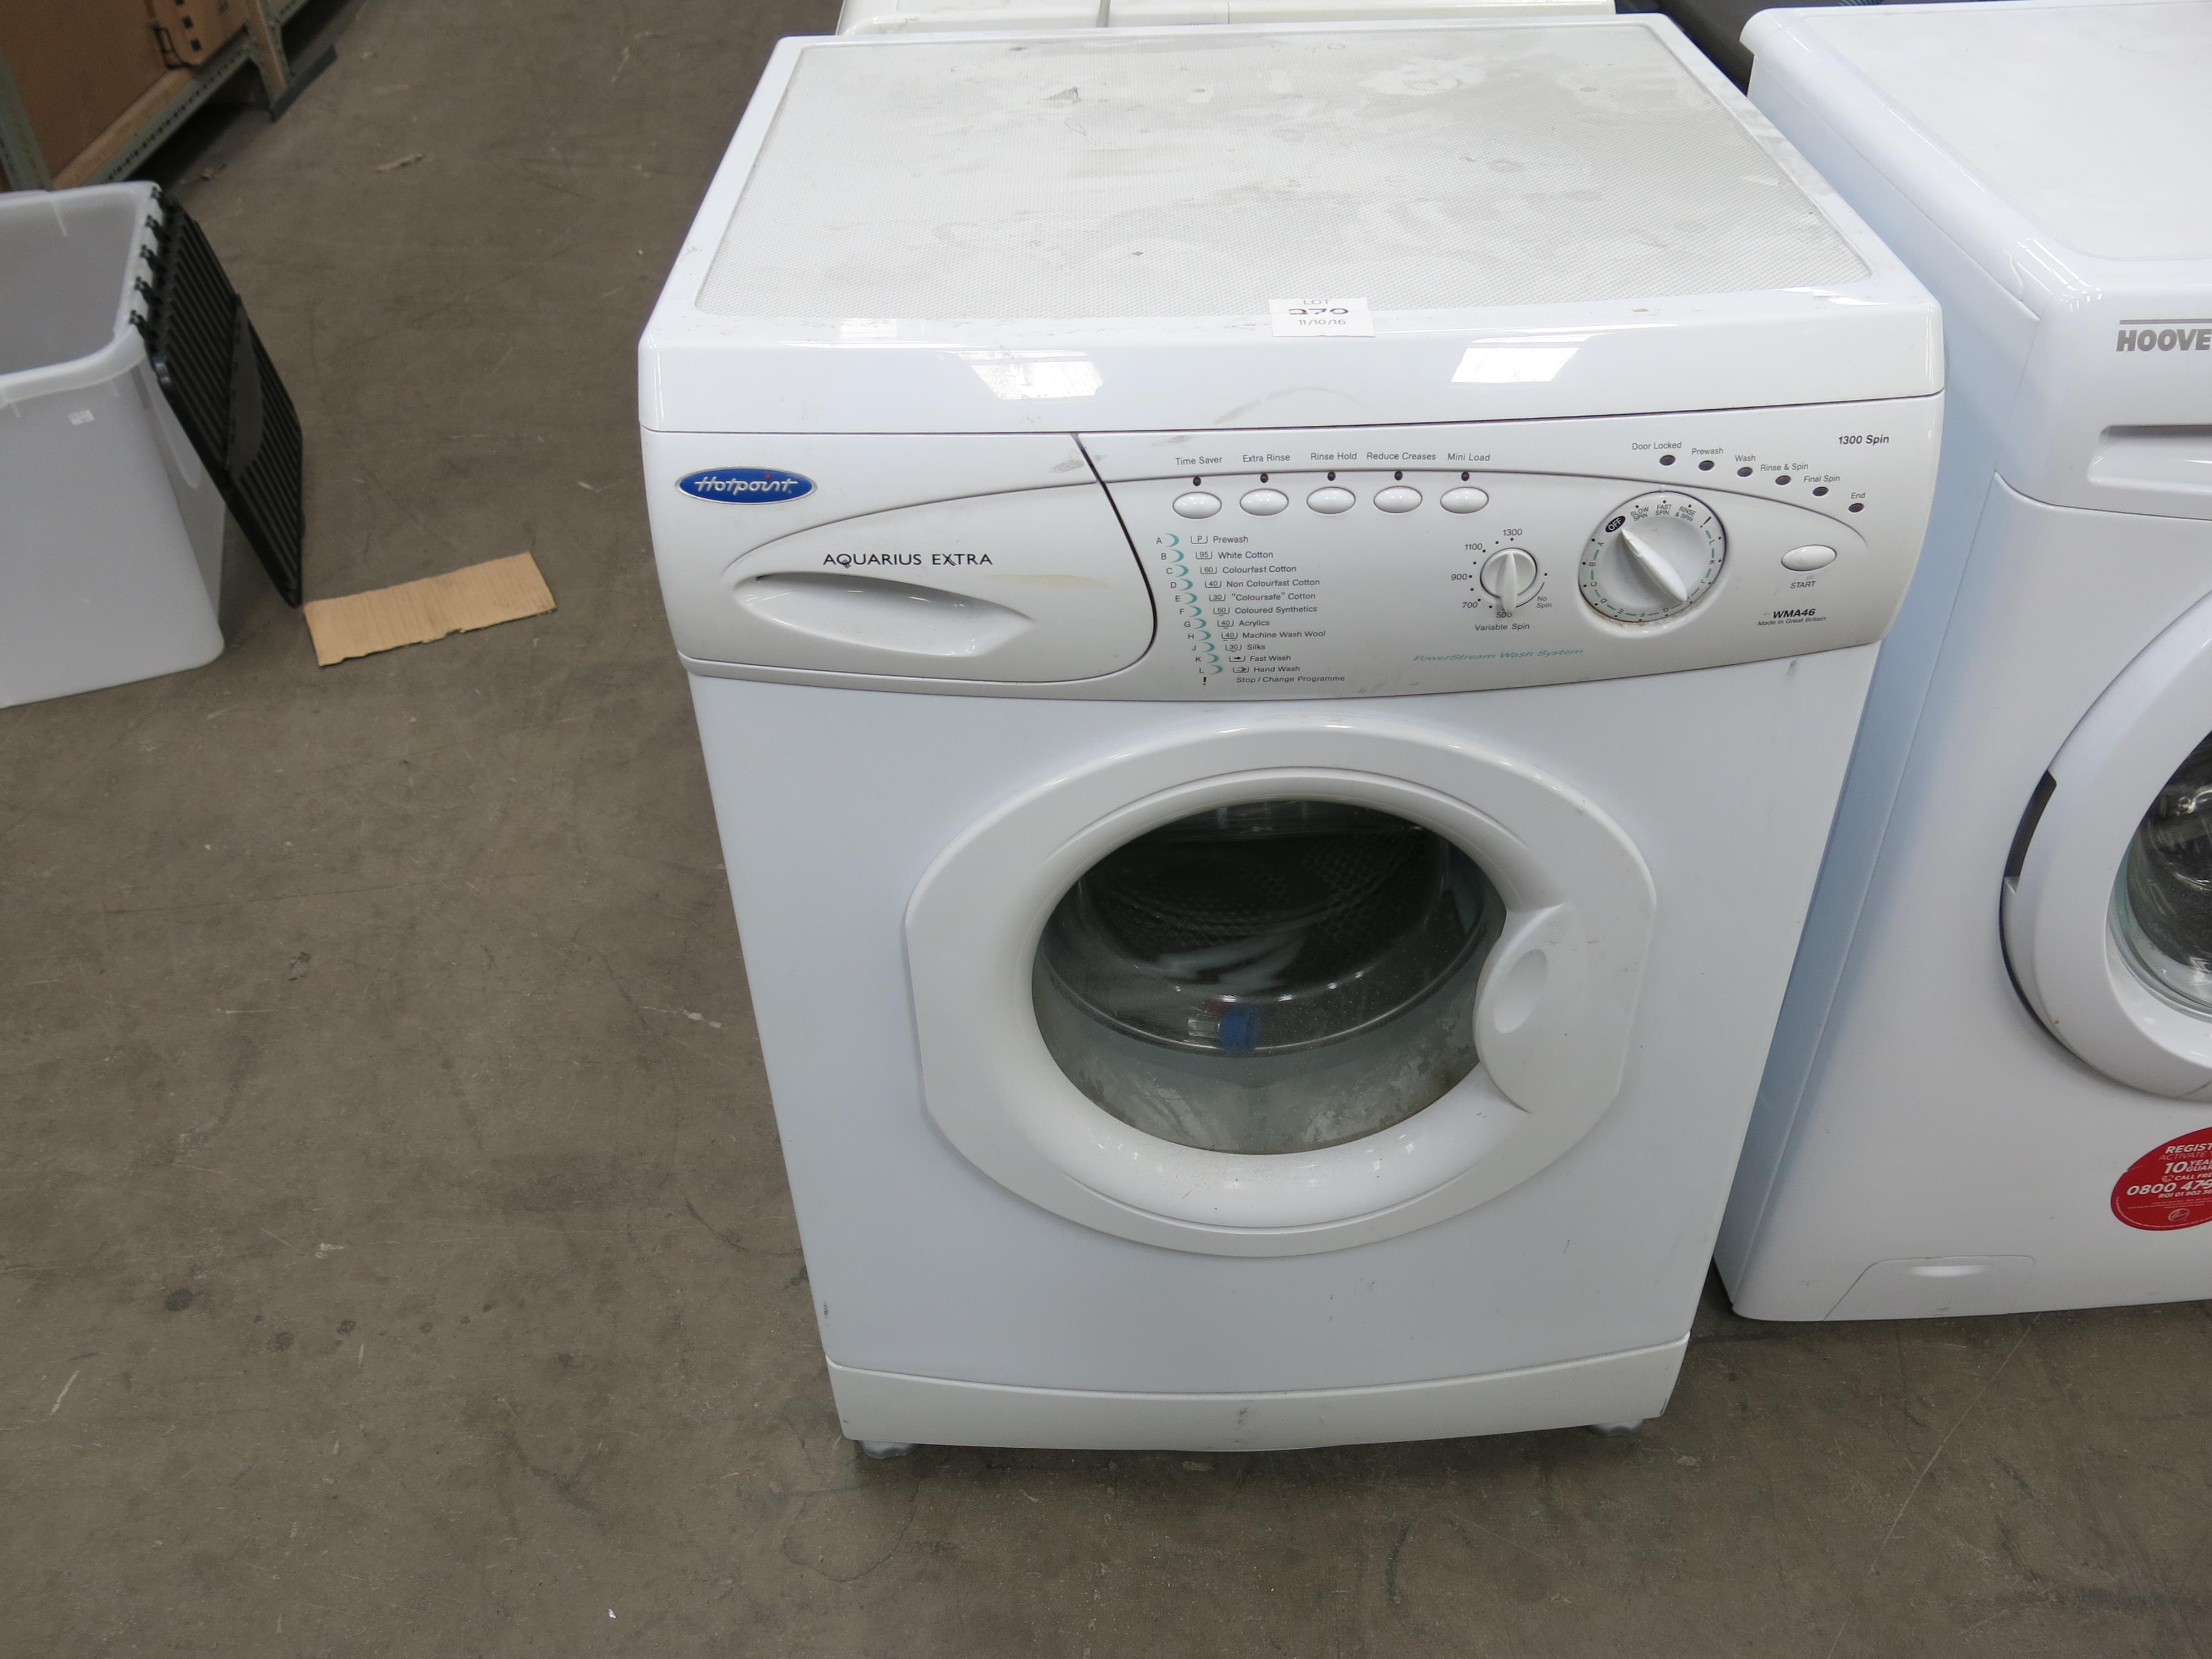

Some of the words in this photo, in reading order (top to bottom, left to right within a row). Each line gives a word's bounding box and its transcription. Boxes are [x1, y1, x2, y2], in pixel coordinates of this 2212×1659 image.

[1838, 435, 1863, 445] 1300
[1865, 434, 1890, 446] Spin
[1632, 442, 1651, 451] Door
[1653, 441, 1682, 450] Locked
[1691, 447, 1724, 455] Prewash
[1198, 456, 1223, 465] Saver
[1243, 455, 1264, 463] Extra
[1266, 453, 1291, 462] Rinse
[1311, 452, 1334, 461] Rinse
[1337, 452, 1357, 460] Hold
[1366, 452, 1400, 460] Reduce
[1401, 452, 1437, 461] Creases
[1447, 452, 1465, 461] Mini
[1468, 453, 1491, 462] Load
[1735, 454, 1756, 462] Wash
[1791, 463, 1809, 472] Spin
[1823, 474, 1840, 483] Spin
[694, 474, 798, 495] Hotpoint
[1608, 518, 1623, 530] OFF
[1503, 528, 1523, 536] 1300
[1156, 536, 1163, 545] A
[1213, 535, 1249, 544] Prewash
[1464, 542, 1483, 551] 1100
[823, 554, 922, 569] AQUARIUS
[932, 554, 993, 566] EXTRA
[1222, 566, 1267, 574] Colourfast
[1246, 579, 1290, 587] Colourfast
[1790, 581, 1817, 589] START
[1232, 592, 1286, 601] "Coloursafe"
[1275, 606, 1318, 614] Synthetics
[1773, 608, 1816, 619] WMA46
[1239, 619, 1270, 628] Acrylics
[2164, 1161, 2188, 1174] 10
[2127, 1182, 2177, 1196] 0800
[2180, 1179, 2212, 1192] 479
